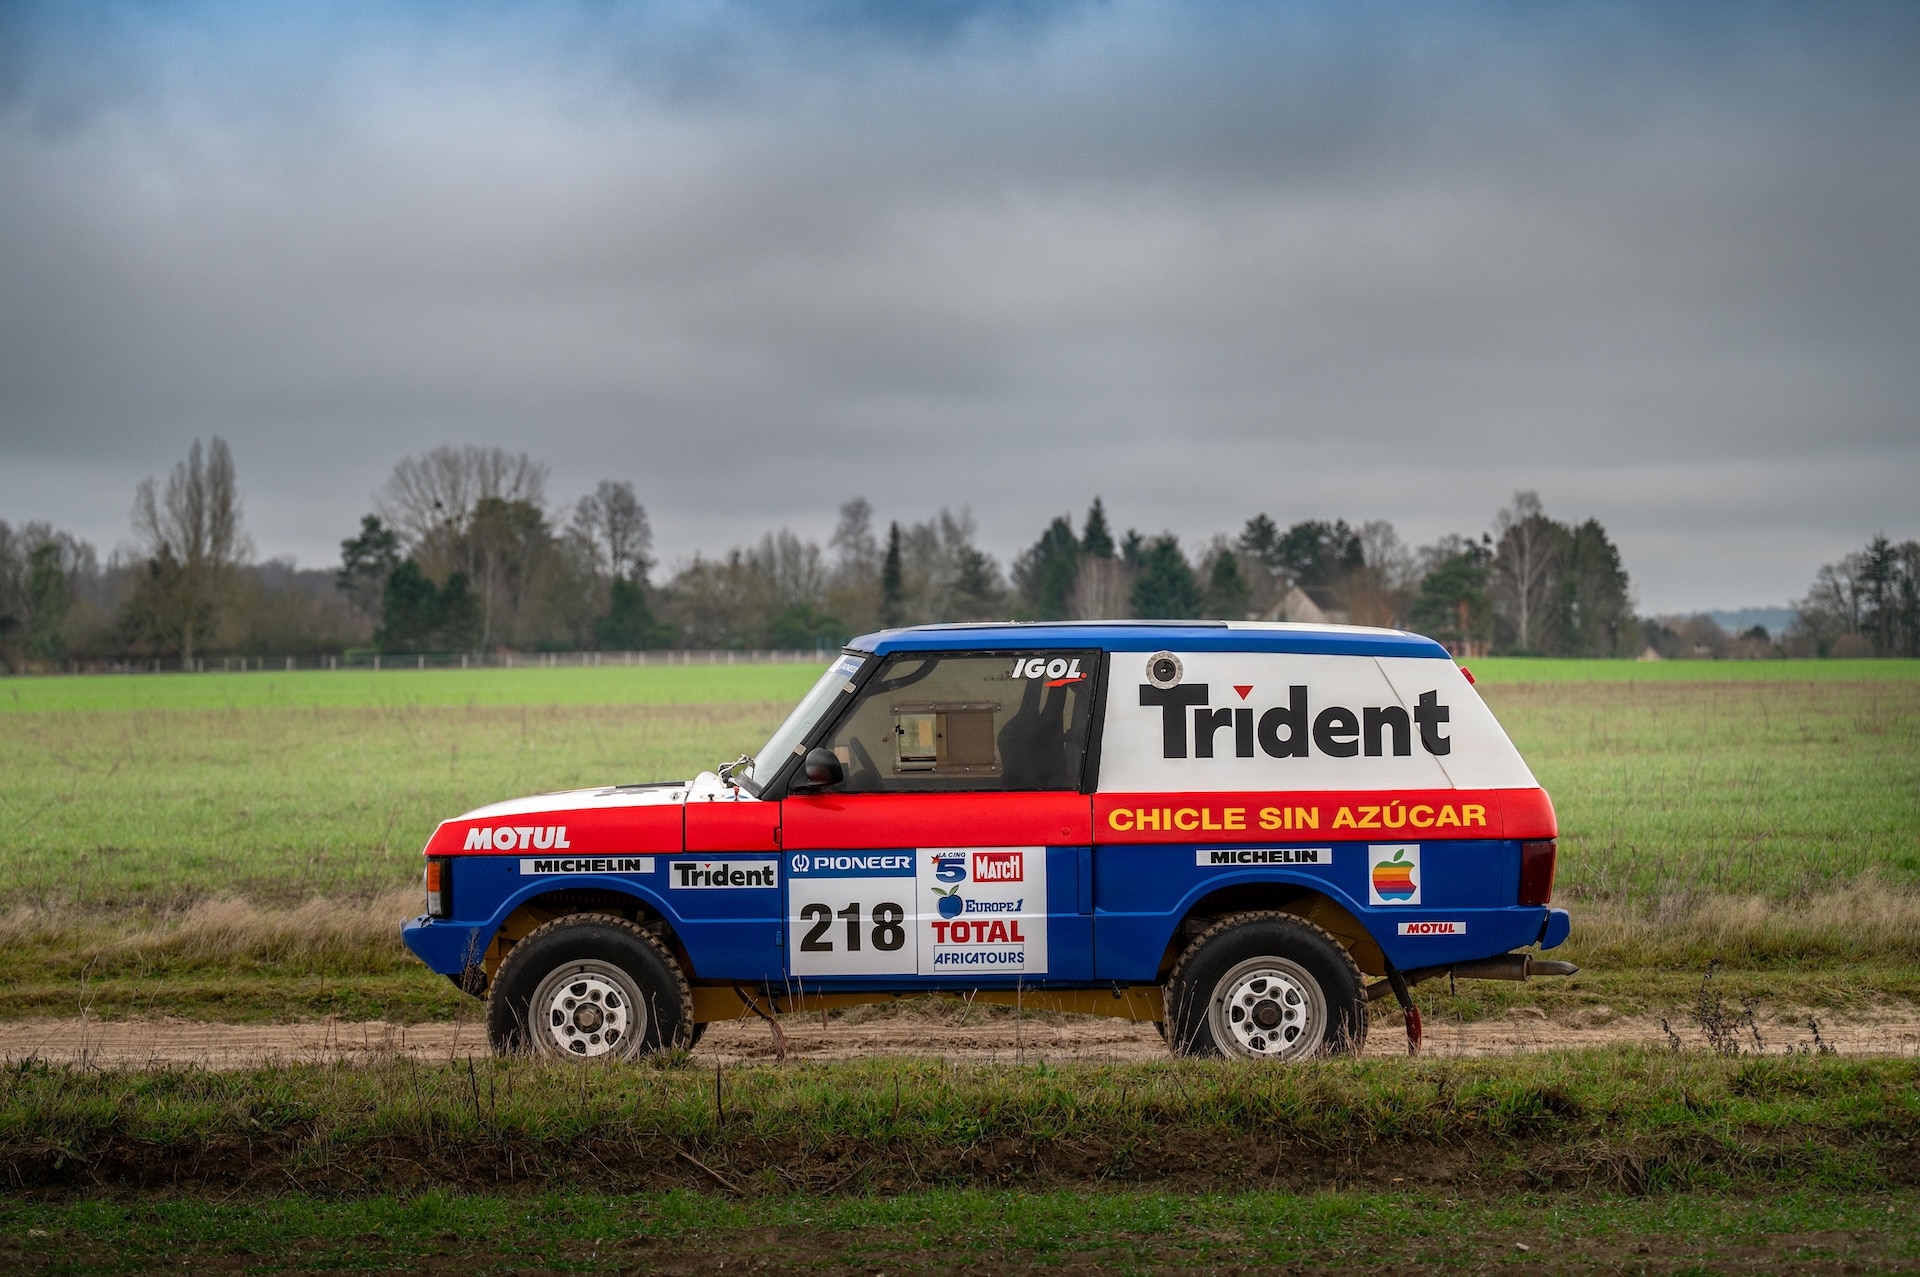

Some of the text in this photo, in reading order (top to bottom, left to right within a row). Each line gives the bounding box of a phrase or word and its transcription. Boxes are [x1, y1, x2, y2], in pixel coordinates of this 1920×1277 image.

[1139, 684, 1451, 759] Trident
[1108, 800, 1487, 831] CHICLE SIN AZÚCAR
[463, 826, 571, 850] MOTUL
[534, 859, 641, 872] MICHELIN
[814, 856, 911, 869] PIONEER
[976, 855, 1020, 879] MATCH
[1210, 851, 1318, 864] MICHELIN
[674, 863, 774, 886] Trident
[936, 859, 966, 883] 5
[800, 902, 906, 952] 218
[931, 920, 1025, 943] TOTAL
[1406, 923, 1455, 934] MOTUL
[934, 951, 1025, 965] AFRICATOURS
